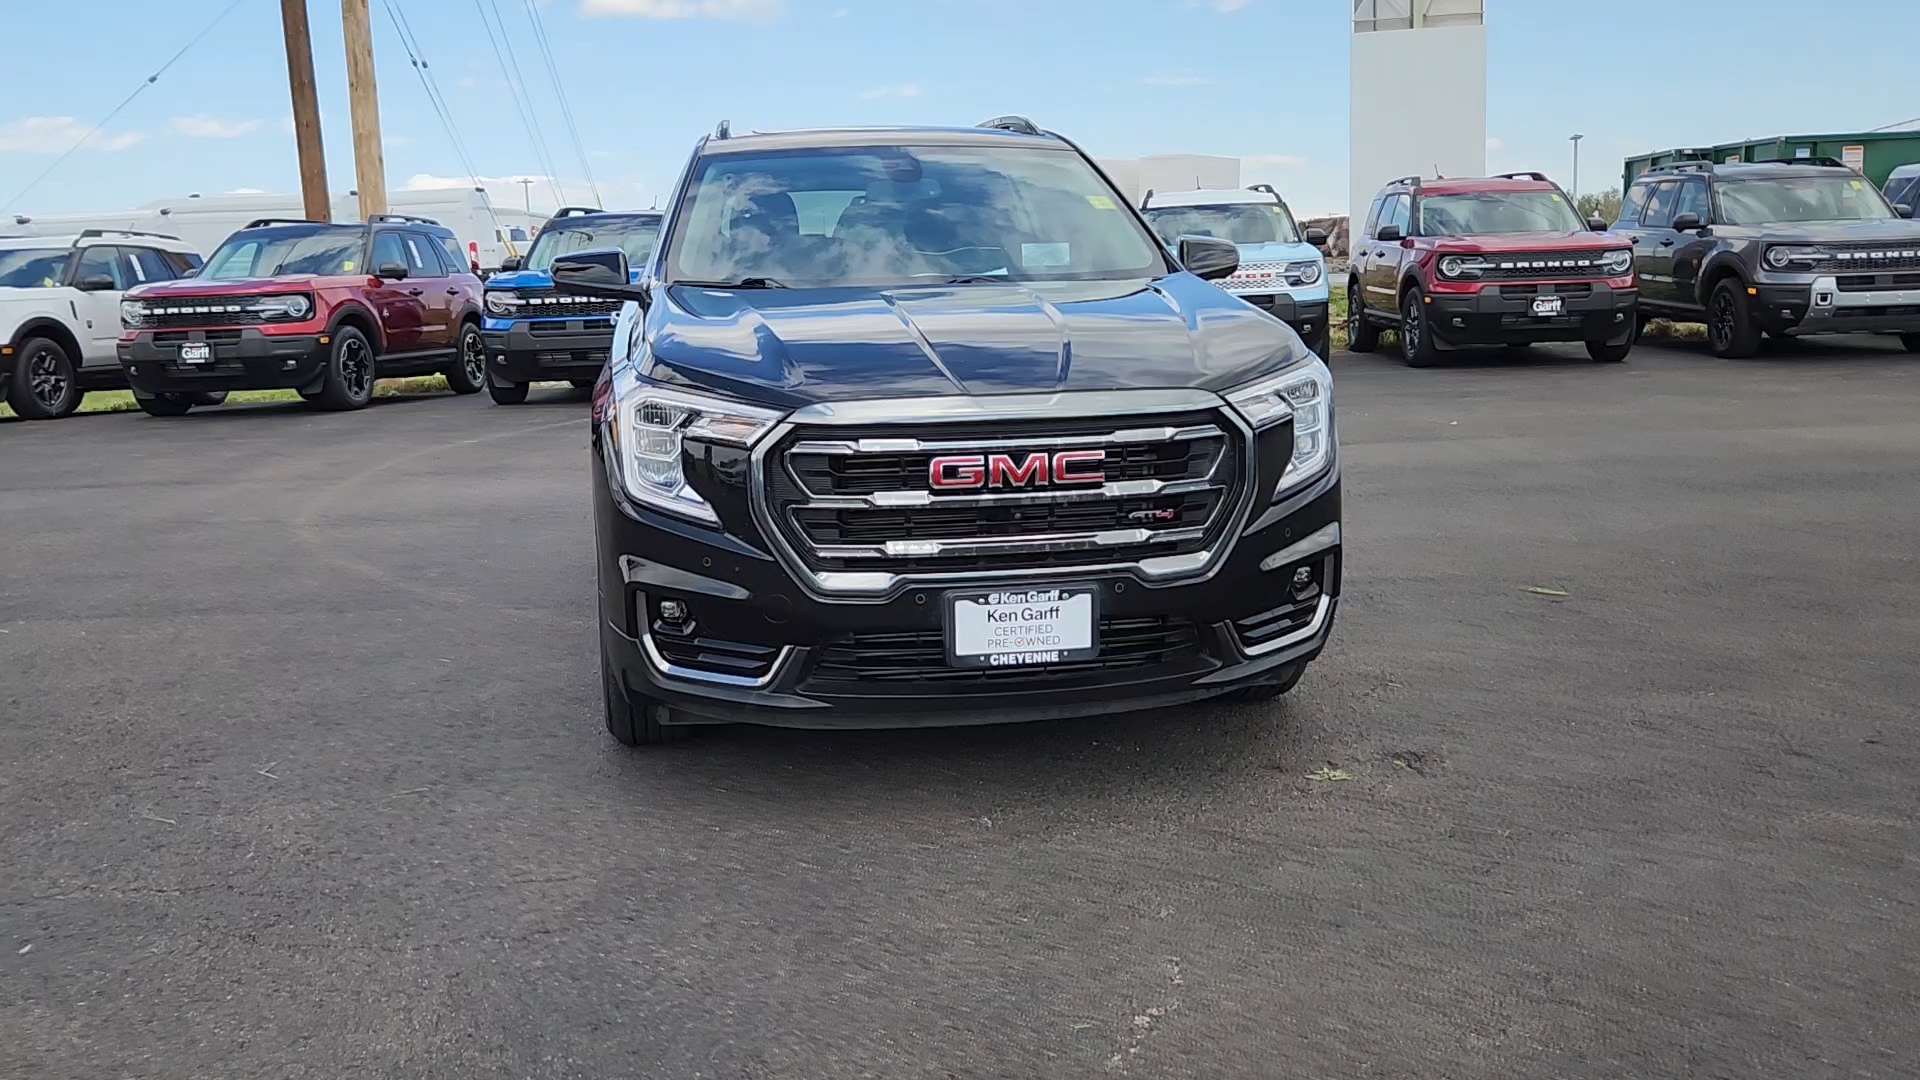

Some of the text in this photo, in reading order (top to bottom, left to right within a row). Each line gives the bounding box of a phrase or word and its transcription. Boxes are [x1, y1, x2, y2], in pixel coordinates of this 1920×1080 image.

[1836, 250, 1920, 260] BRONC
[1500, 259, 1591, 269] BRONCO
[528, 296, 619, 305] BRONC
[1532, 299, 1562, 313] Garff
[153, 305, 242, 316] BRONCO
[181, 346, 210, 359] Garff
[929, 449, 1106, 490] GMC
[1128, 508, 1175, 522] AT4
[1000, 589, 1061, 605] Ken Garff
[987, 605, 1061, 623] Ken Garff
[994, 623, 1054, 637] CERTIFIED
[987, 635, 1061, 649] PRE-OWNED
[989, 651, 1060, 666] CHEYENNE
